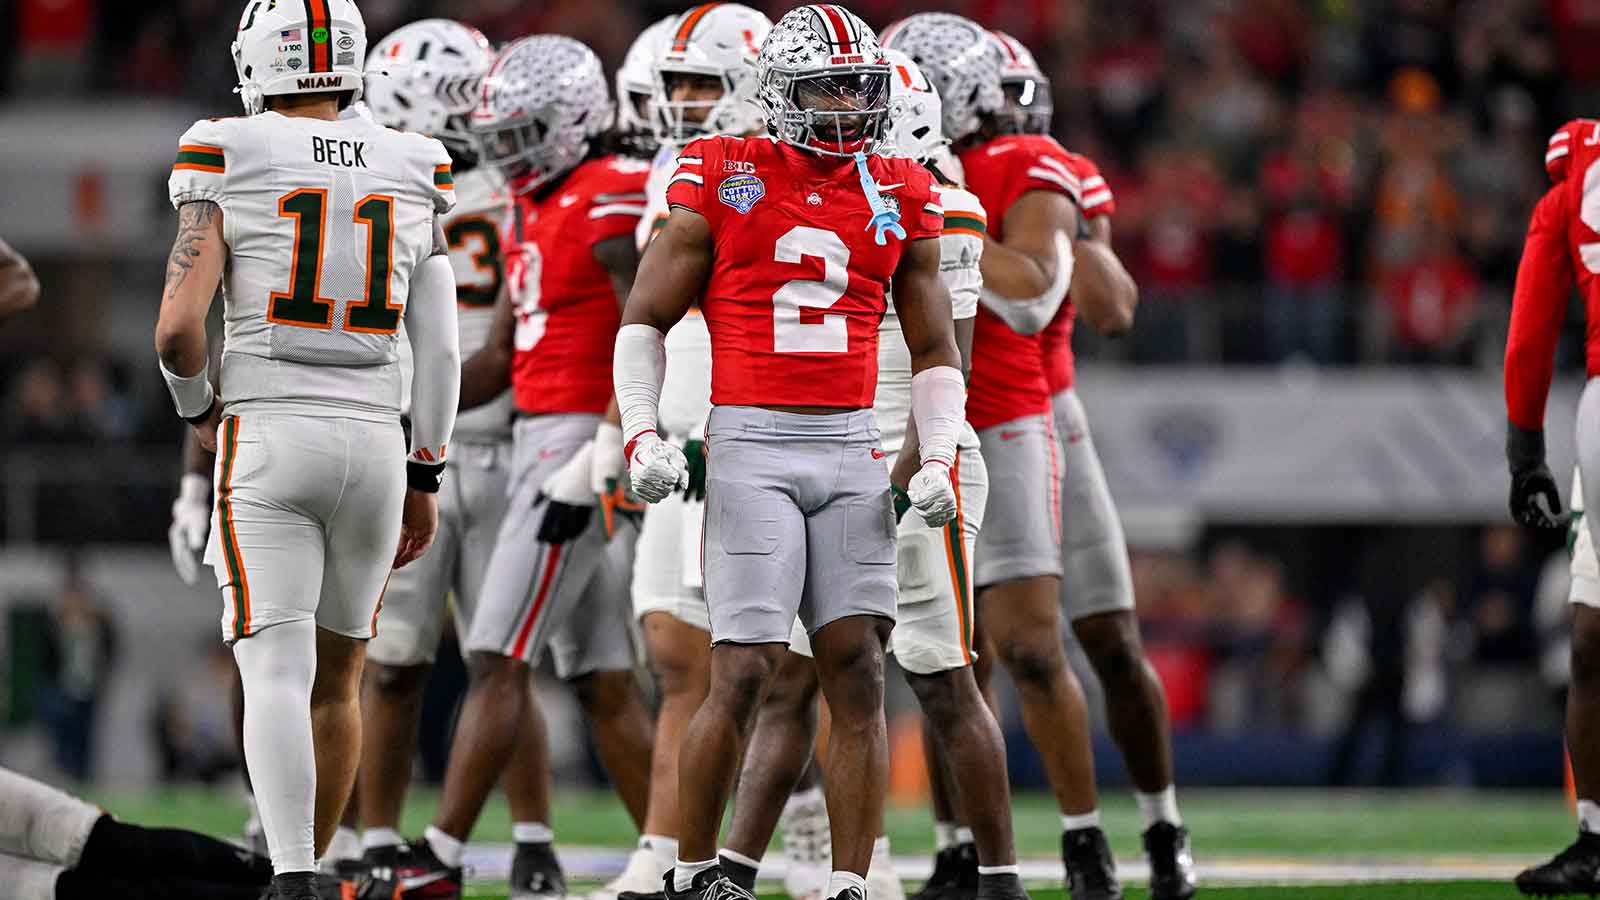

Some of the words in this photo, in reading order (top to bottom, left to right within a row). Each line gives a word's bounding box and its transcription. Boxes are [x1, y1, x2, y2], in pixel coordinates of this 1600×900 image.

[296, 76, 342, 90] MIAMI
[312, 136, 367, 168] BECK
[722, 184, 761, 200] COTTON
[266, 187, 404, 335] 11
[772, 225, 851, 353] 2
